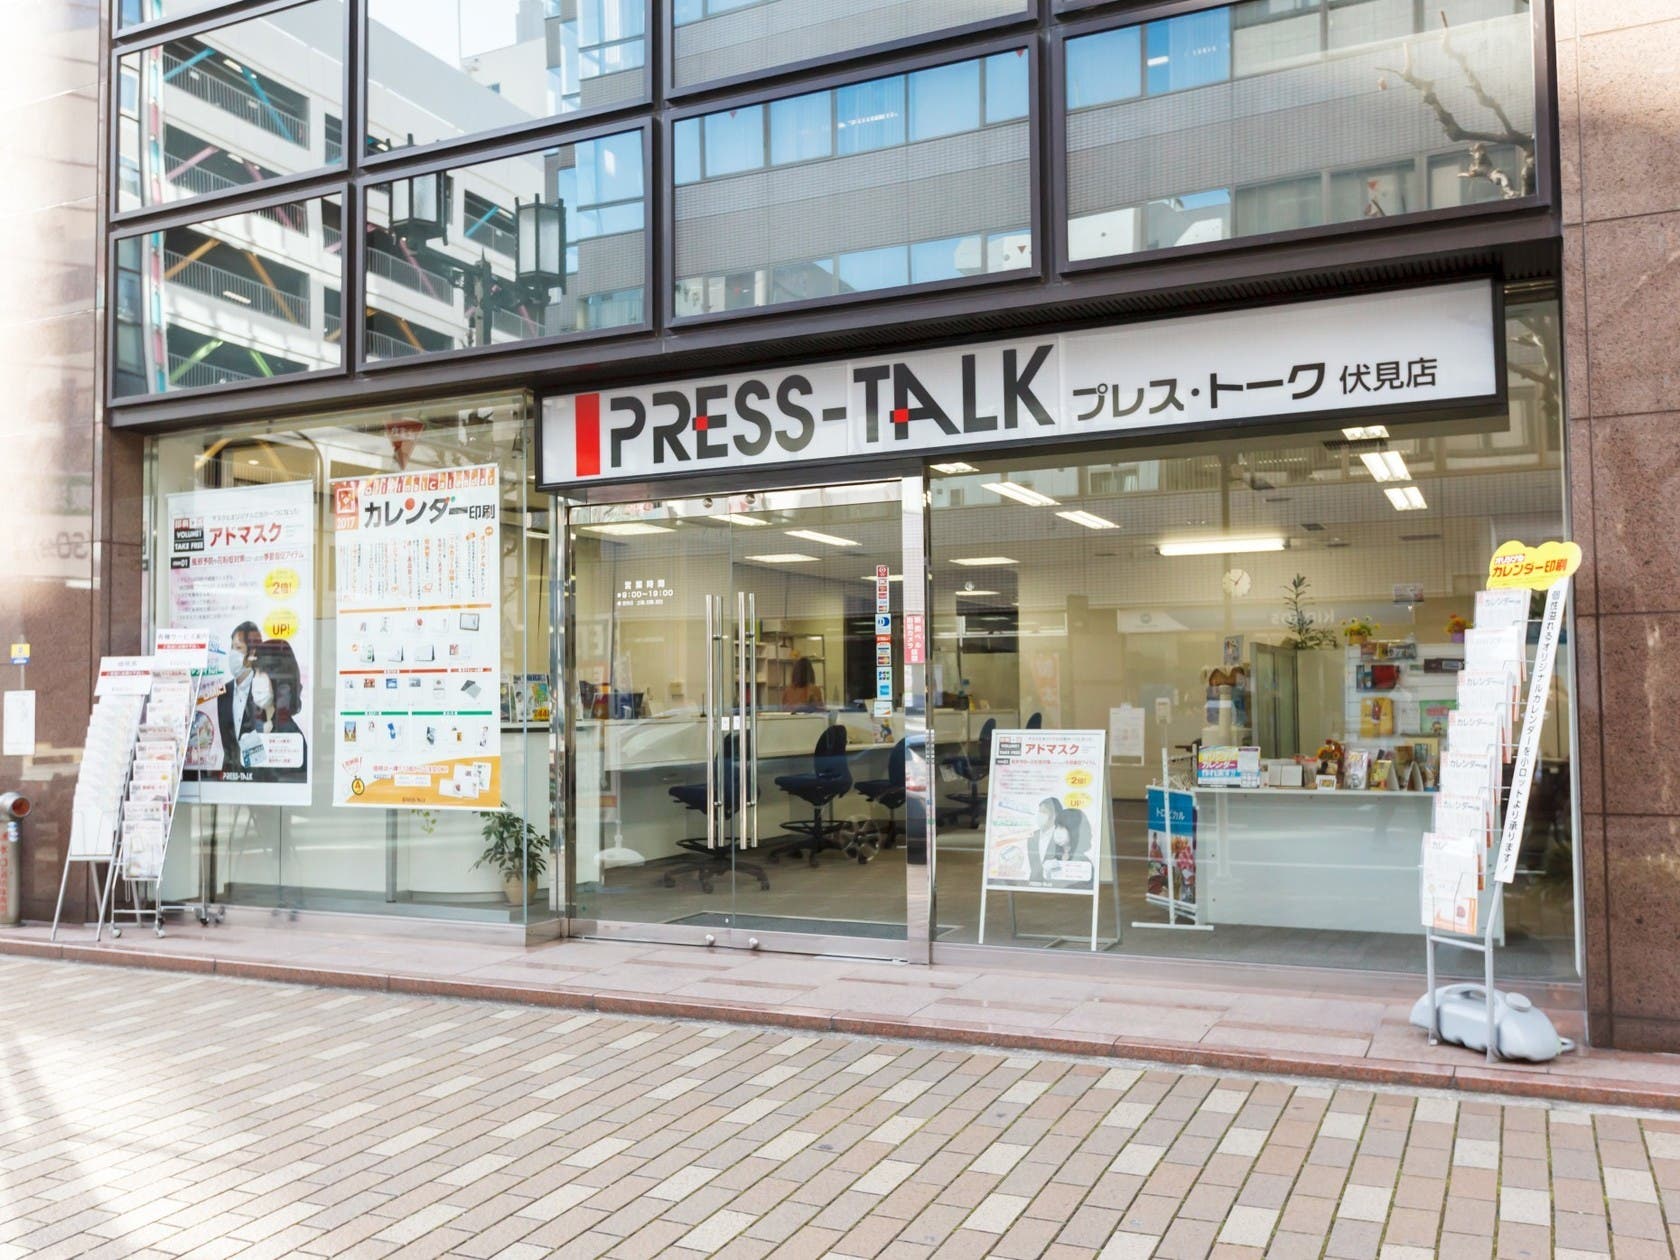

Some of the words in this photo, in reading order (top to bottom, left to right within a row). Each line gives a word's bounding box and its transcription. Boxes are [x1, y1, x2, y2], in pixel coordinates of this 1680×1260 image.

[1072, 362, 1326, 422] プレス・トーク
[1339, 357, 1439, 396] 伏見店
[609, 343, 1057, 470] PRESS-TALK
[337, 516, 355, 530] 2017
[209, 521, 283, 548] アドマスク
[1492, 558, 1568, 578] カレンダー印刷
[272, 622, 291, 636] UP!
[1025, 743, 1080, 756] アドマスク
